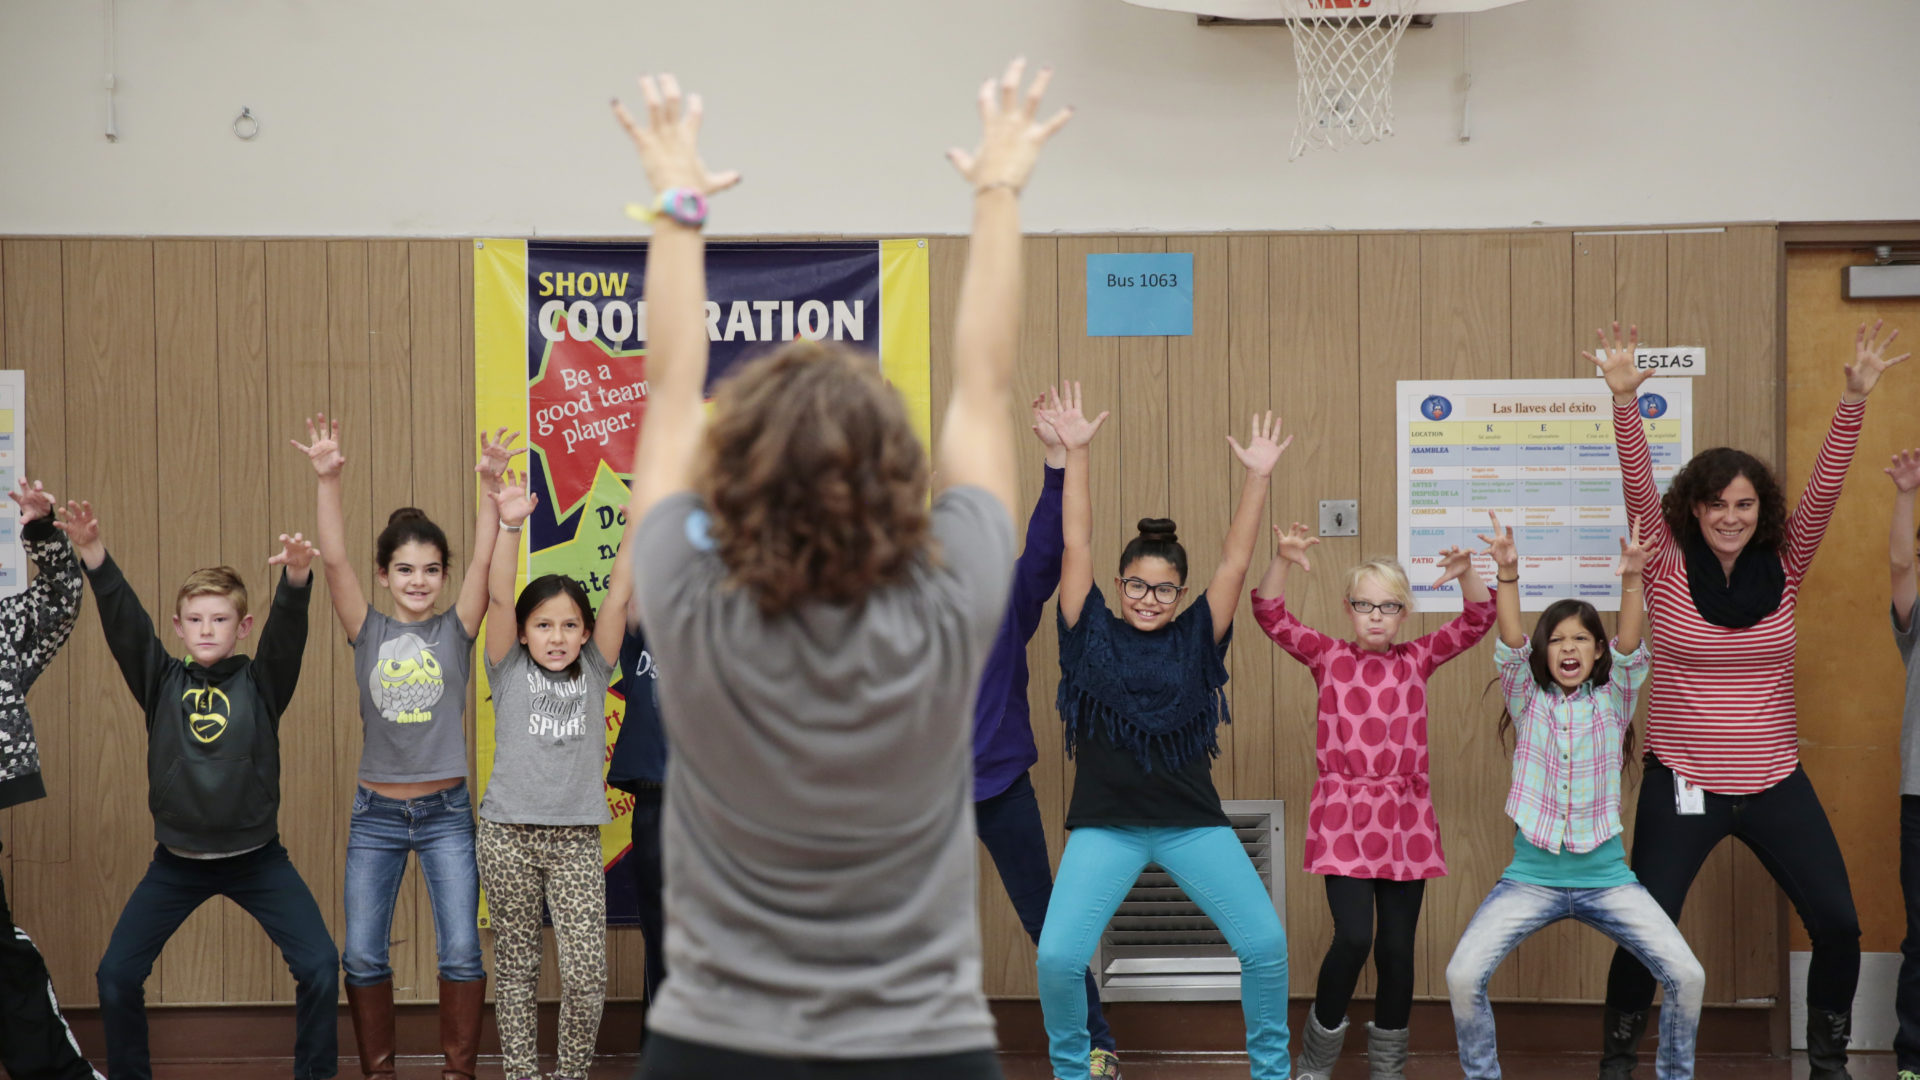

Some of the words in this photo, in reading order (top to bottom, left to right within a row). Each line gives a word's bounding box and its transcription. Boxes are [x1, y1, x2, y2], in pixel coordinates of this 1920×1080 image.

[538, 272, 629, 297] SHOW
[1107, 273, 1135, 288] Bus
[1140, 273, 1178, 288] 1063
[538, 300, 864, 342] COORATION
[1635, 354, 1694, 369] ESIAS
[560, 368, 593, 391] Be
[597, 364, 612, 380] a
[536, 391, 594, 436] good
[597, 380, 650, 407] team
[1492, 402, 1512, 414] Las
[1515, 402, 1547, 414] llaves
[1549, 402, 1566, 414] del
[1568, 402, 1597, 414] éxito
[562, 412, 636, 454] player.
[1486, 424, 1494, 432] K
[1540, 423, 1547, 432] E
[1595, 423, 1601, 431] Y
[1650, 422, 1656, 431] S
[528, 713, 587, 738] SPURS
